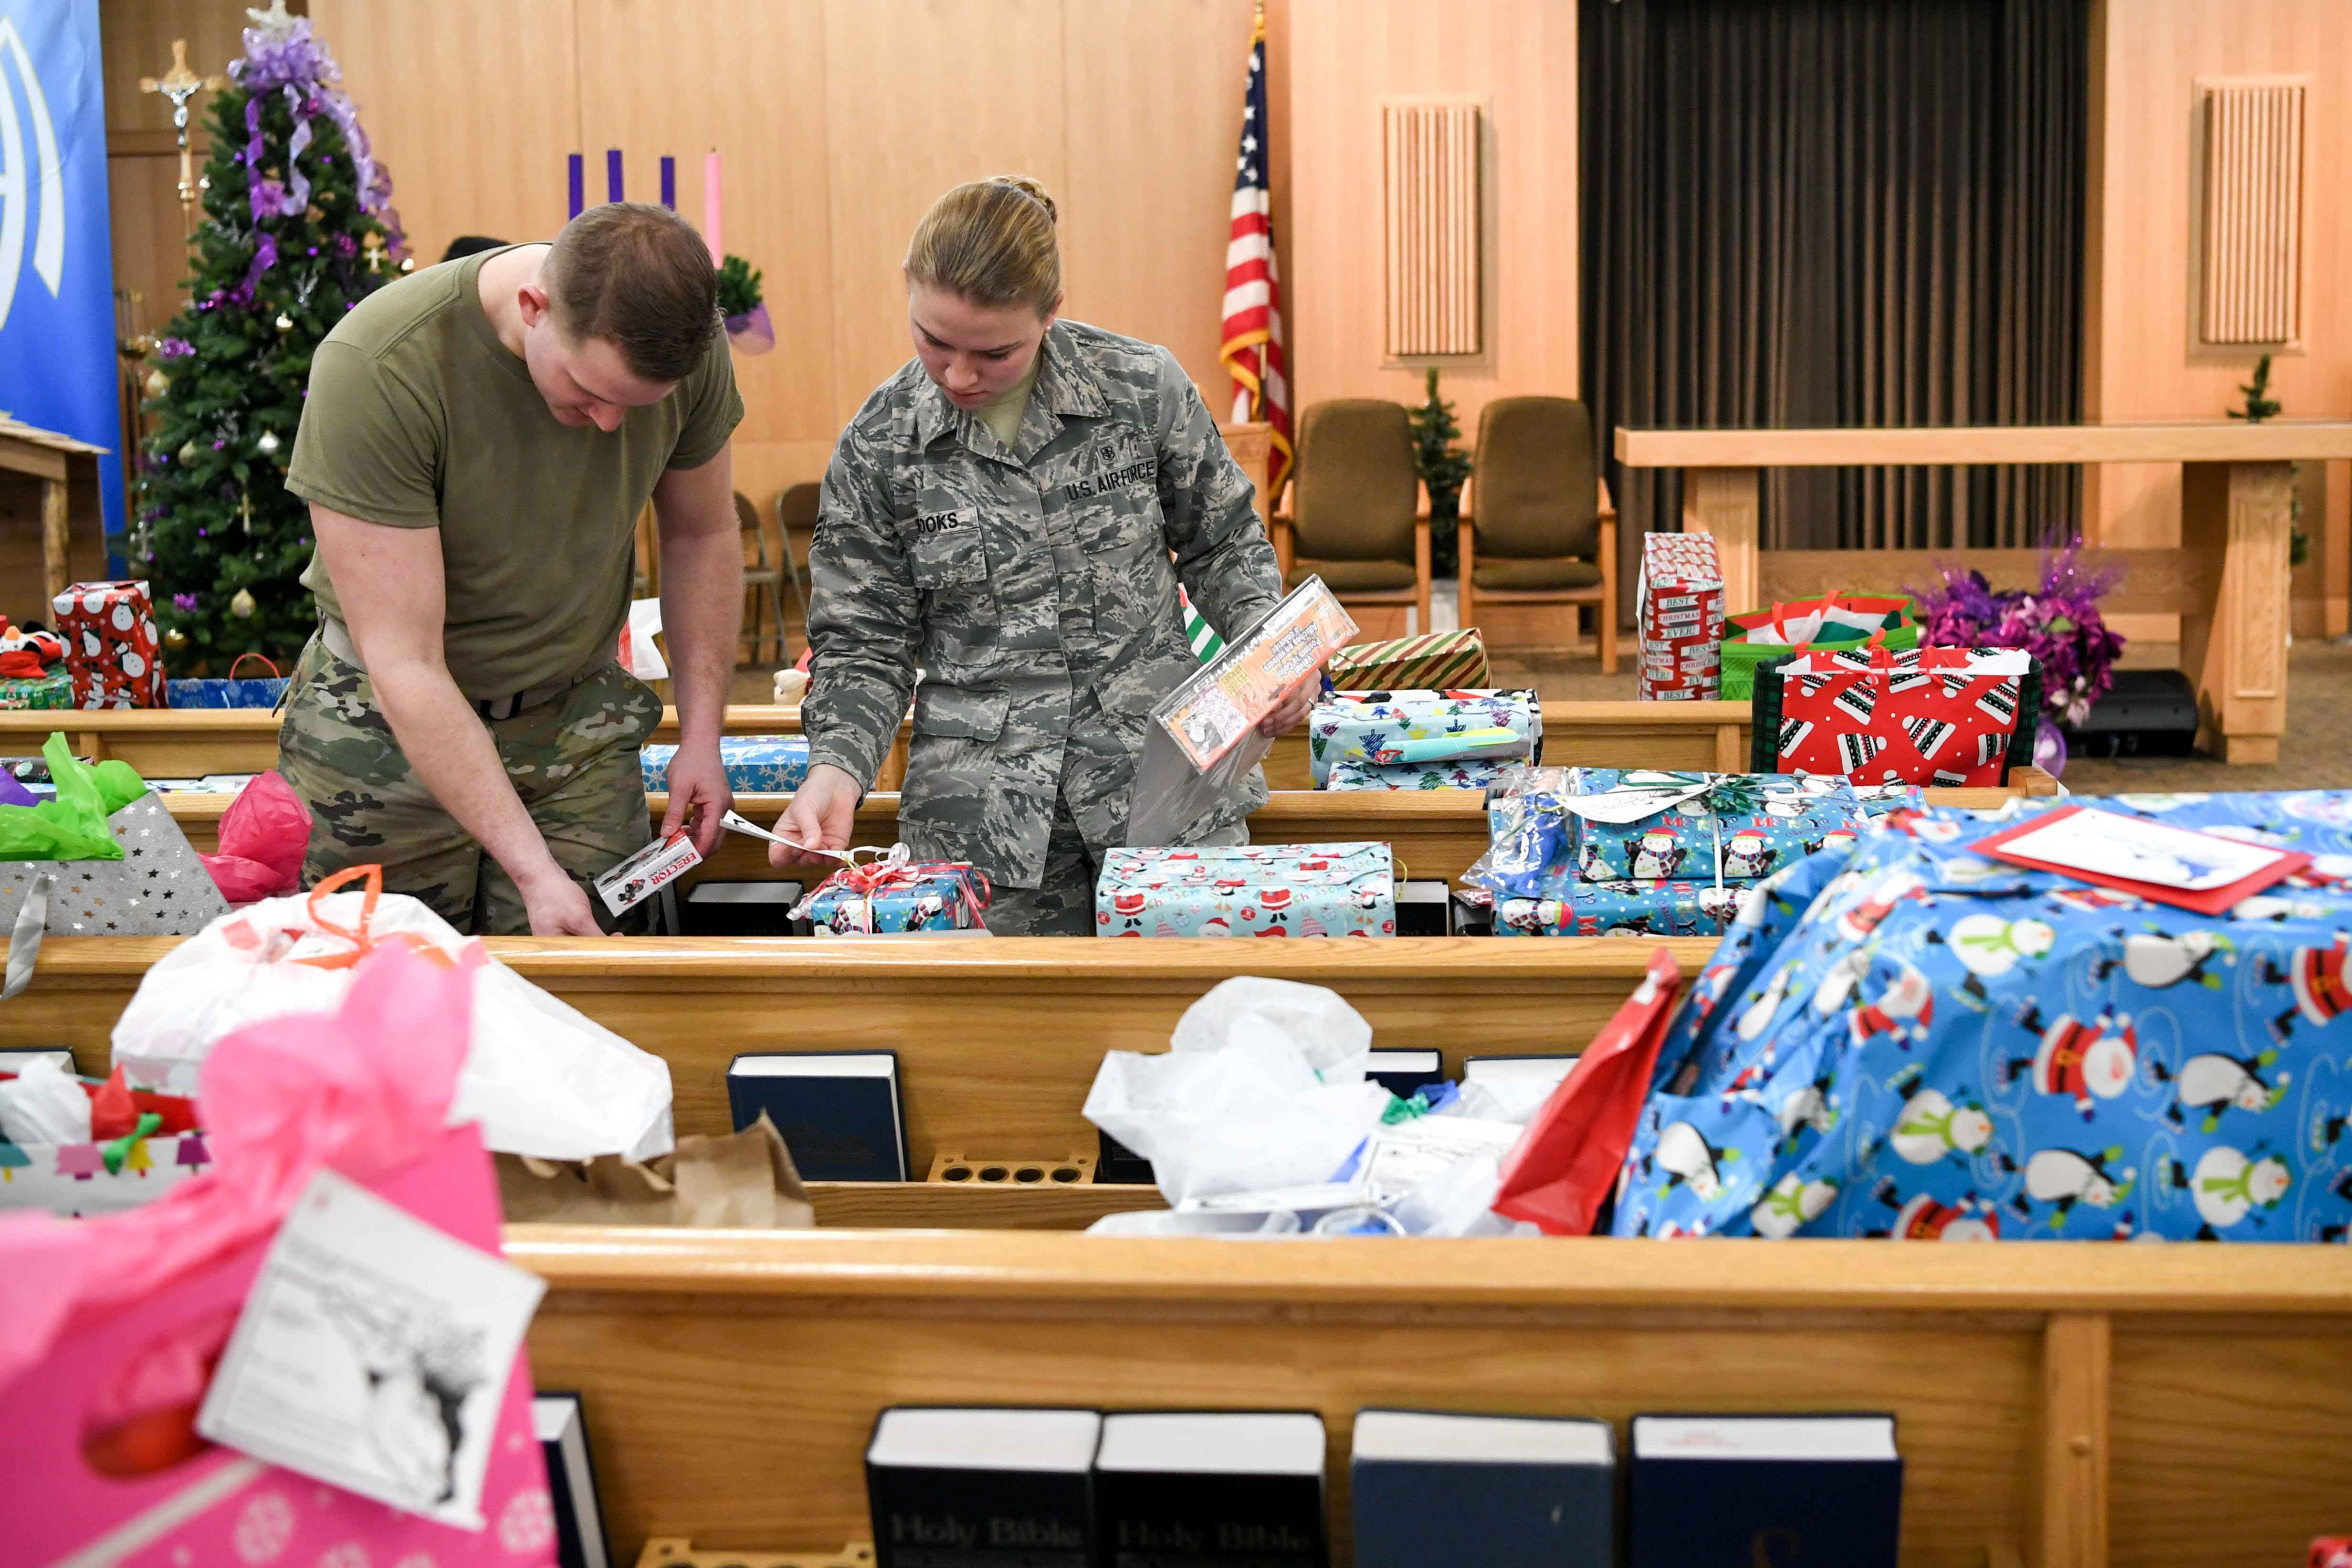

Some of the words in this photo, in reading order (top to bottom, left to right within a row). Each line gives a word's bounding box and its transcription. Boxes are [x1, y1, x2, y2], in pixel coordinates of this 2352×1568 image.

[1069, 479, 1097, 501] U.S.
[1098, 472, 1120, 493] AIR
[1122, 460, 1155, 486] FORCE
[1667, 597, 1690, 607] BEST
[1659, 610, 1700, 622] CHRISTMAS
[1667, 626, 1696, 638] EVER!
[1276, 661, 1294, 678] Color
[1294, 655, 1315, 675] Velvet
[1663, 691, 1686, 700] BEST
[651, 852, 697, 885] ERECTOR
[891, 1513, 978, 1547] Holy
[989, 1516, 1082, 1547] Bible
[1117, 1519, 1204, 1552] Holy
[1218, 1522, 1312, 1550] Bible
